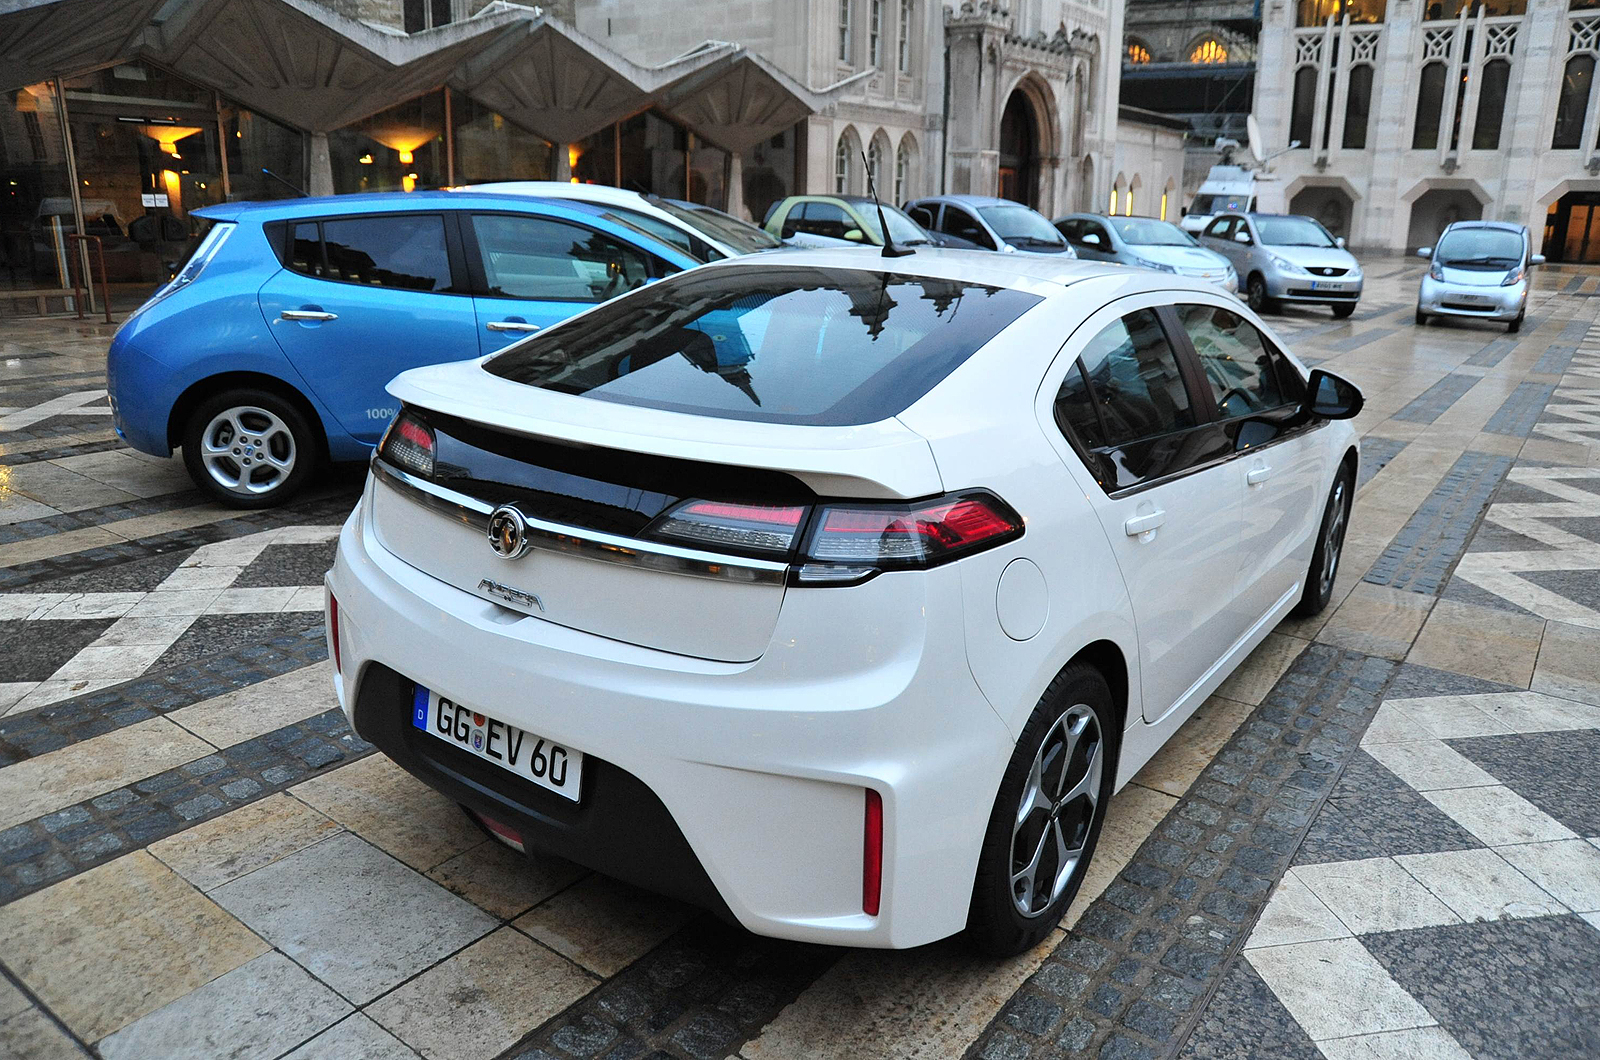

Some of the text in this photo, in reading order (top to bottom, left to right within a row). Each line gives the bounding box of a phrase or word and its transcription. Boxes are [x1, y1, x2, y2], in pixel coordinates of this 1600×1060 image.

[417, 697, 568, 787] D GG EV 60
